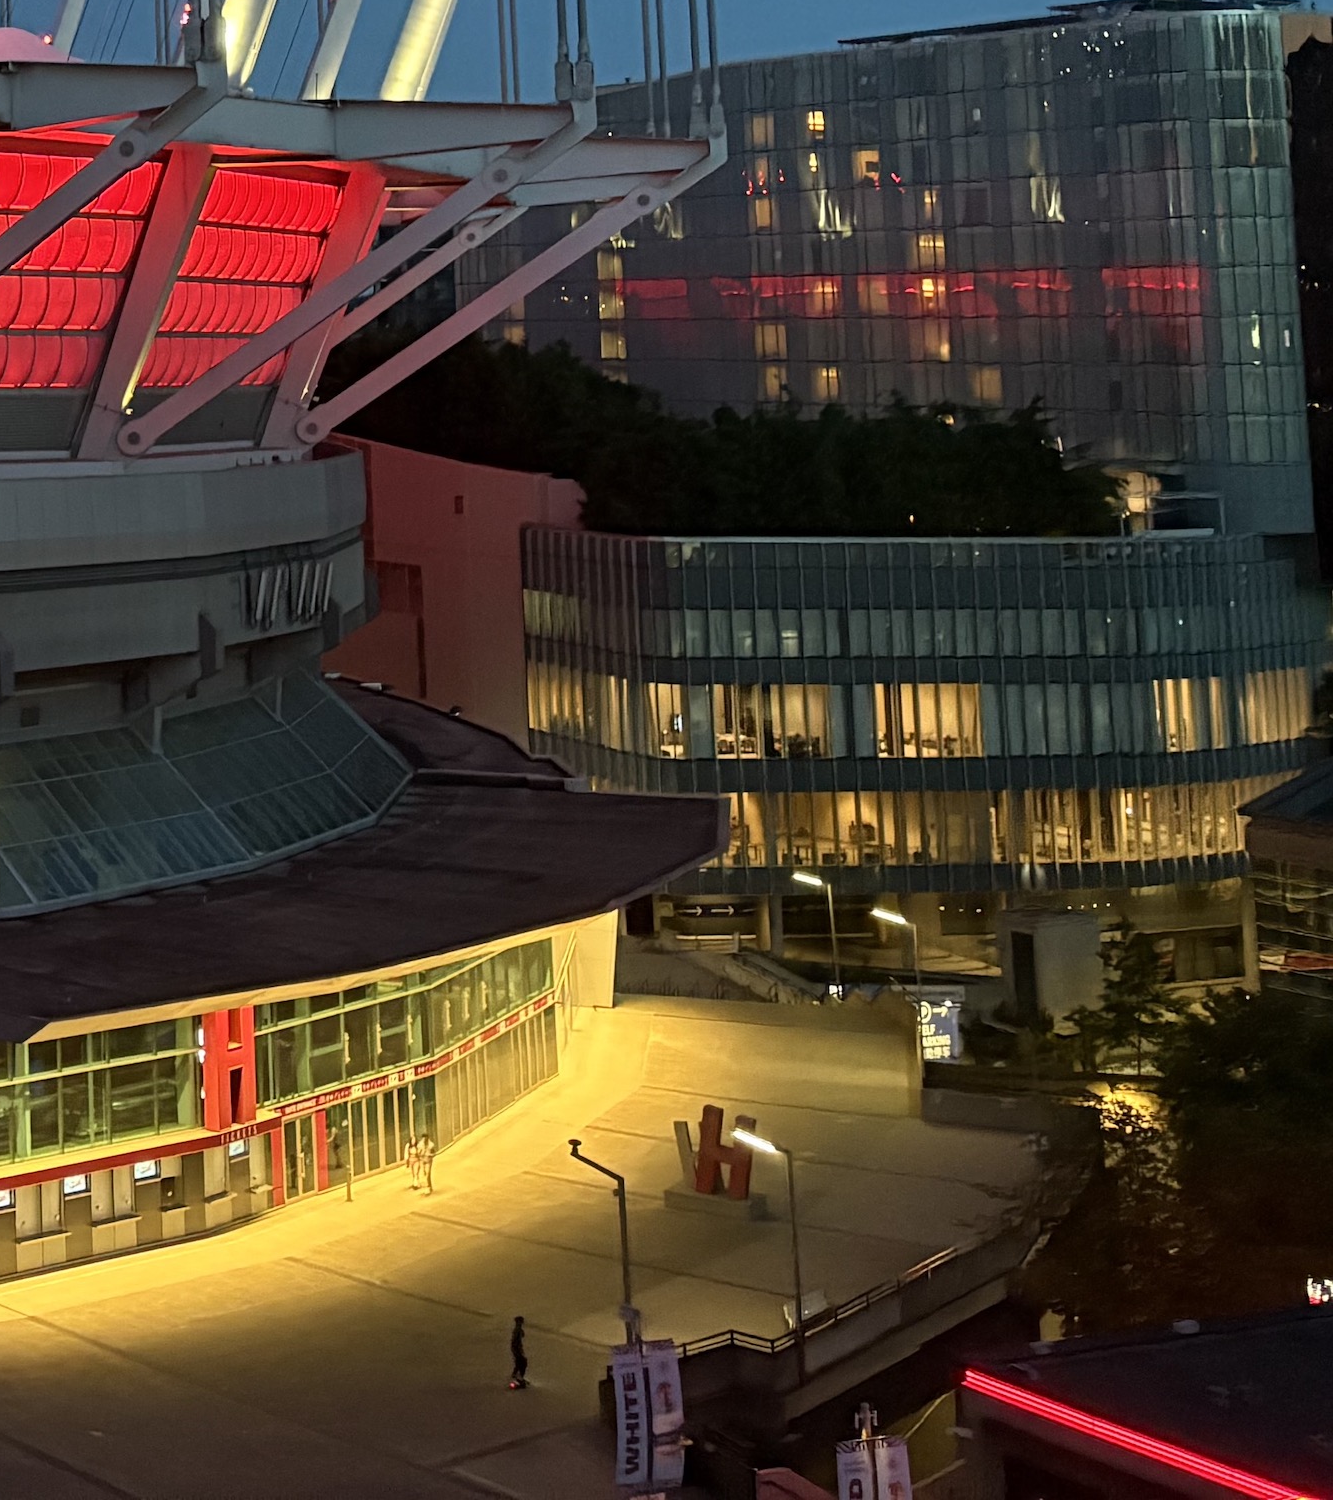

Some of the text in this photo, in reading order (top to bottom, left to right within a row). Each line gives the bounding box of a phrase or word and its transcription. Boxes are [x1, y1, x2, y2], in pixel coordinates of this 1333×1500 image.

[917, 1024, 936, 1036] ELF
[220, 1125, 258, 1145] TICKETS
[622, 1372, 641, 1476] WHITE
